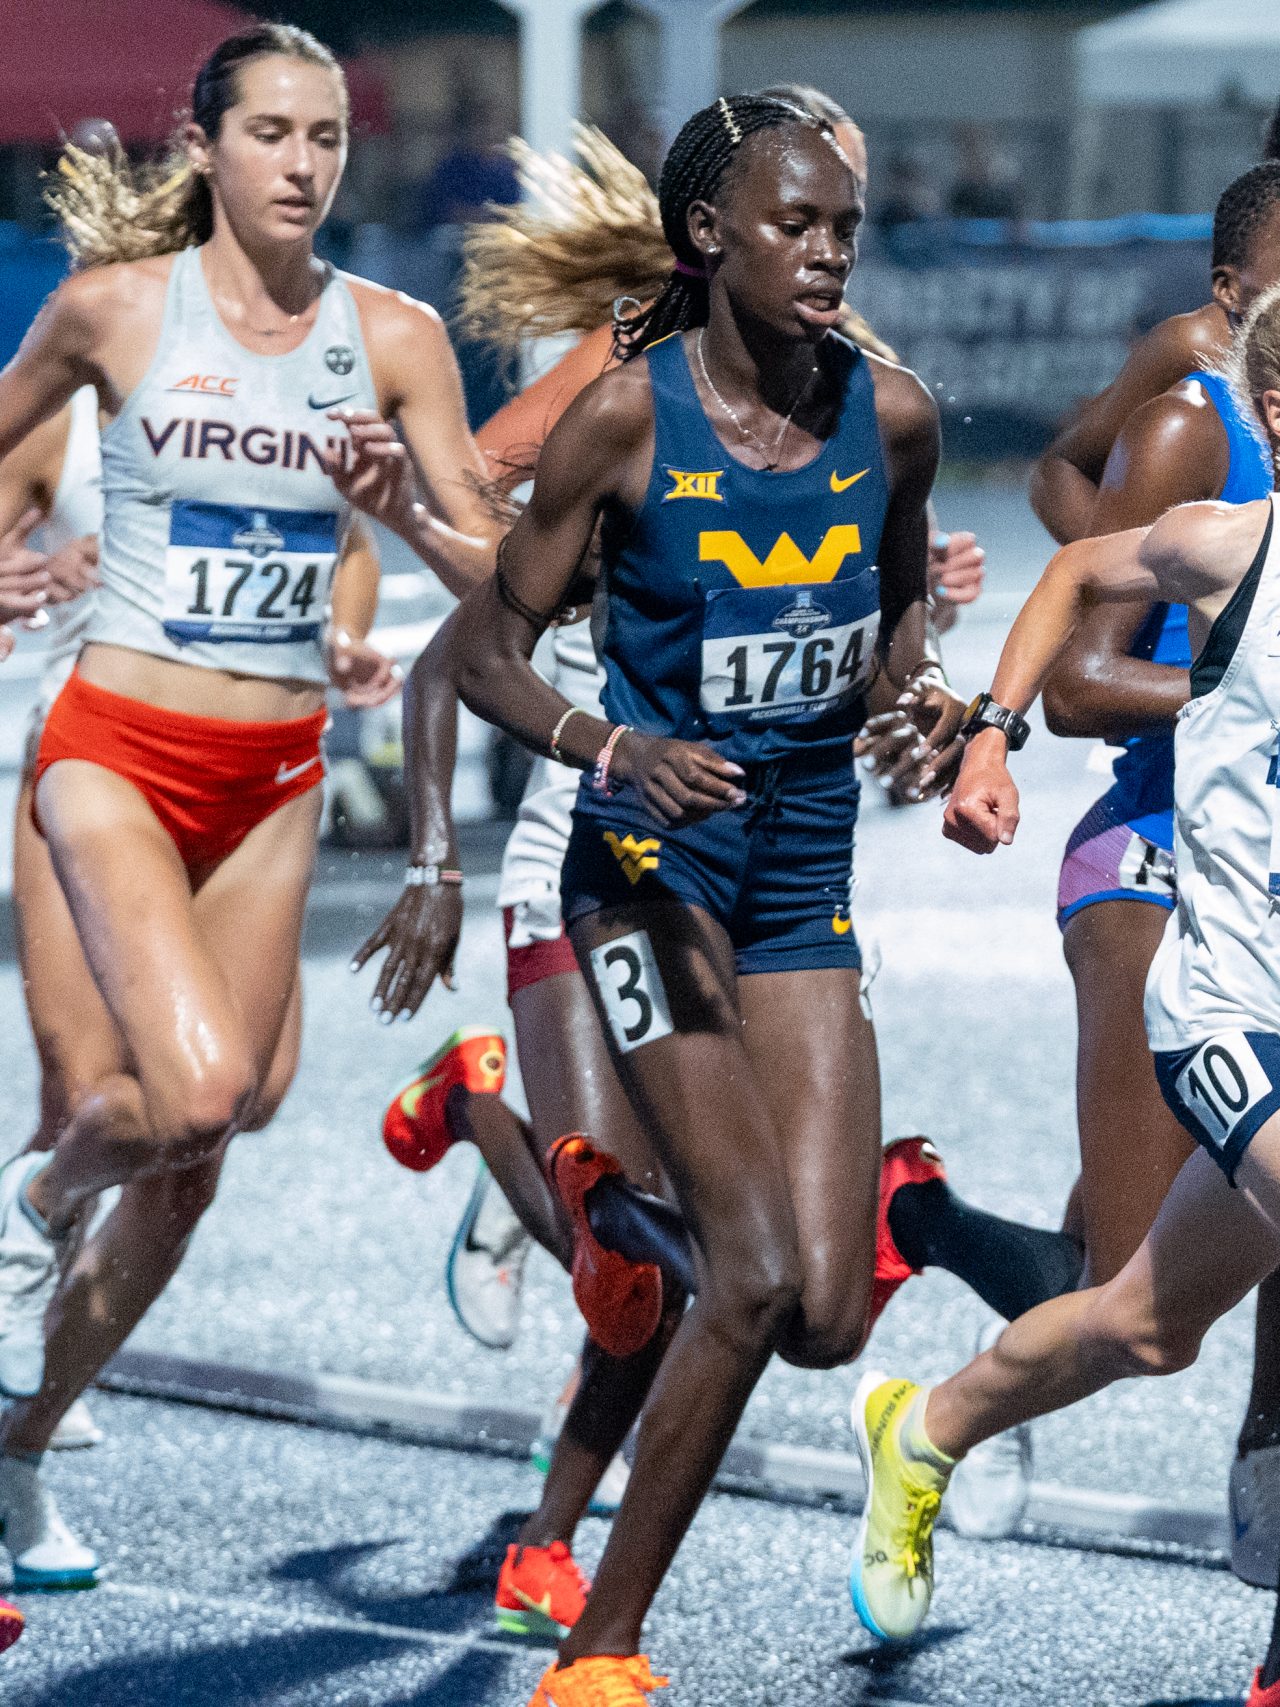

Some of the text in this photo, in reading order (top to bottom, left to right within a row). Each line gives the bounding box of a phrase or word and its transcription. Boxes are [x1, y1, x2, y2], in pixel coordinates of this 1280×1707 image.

[174, 374, 240, 393] ACC
[666, 469, 725, 501] XII
[187, 558, 319, 618] 1724
[725, 628, 865, 707] 1764
[604, 945, 653, 1042] 3
[1187, 1044, 1250, 1133] 10
